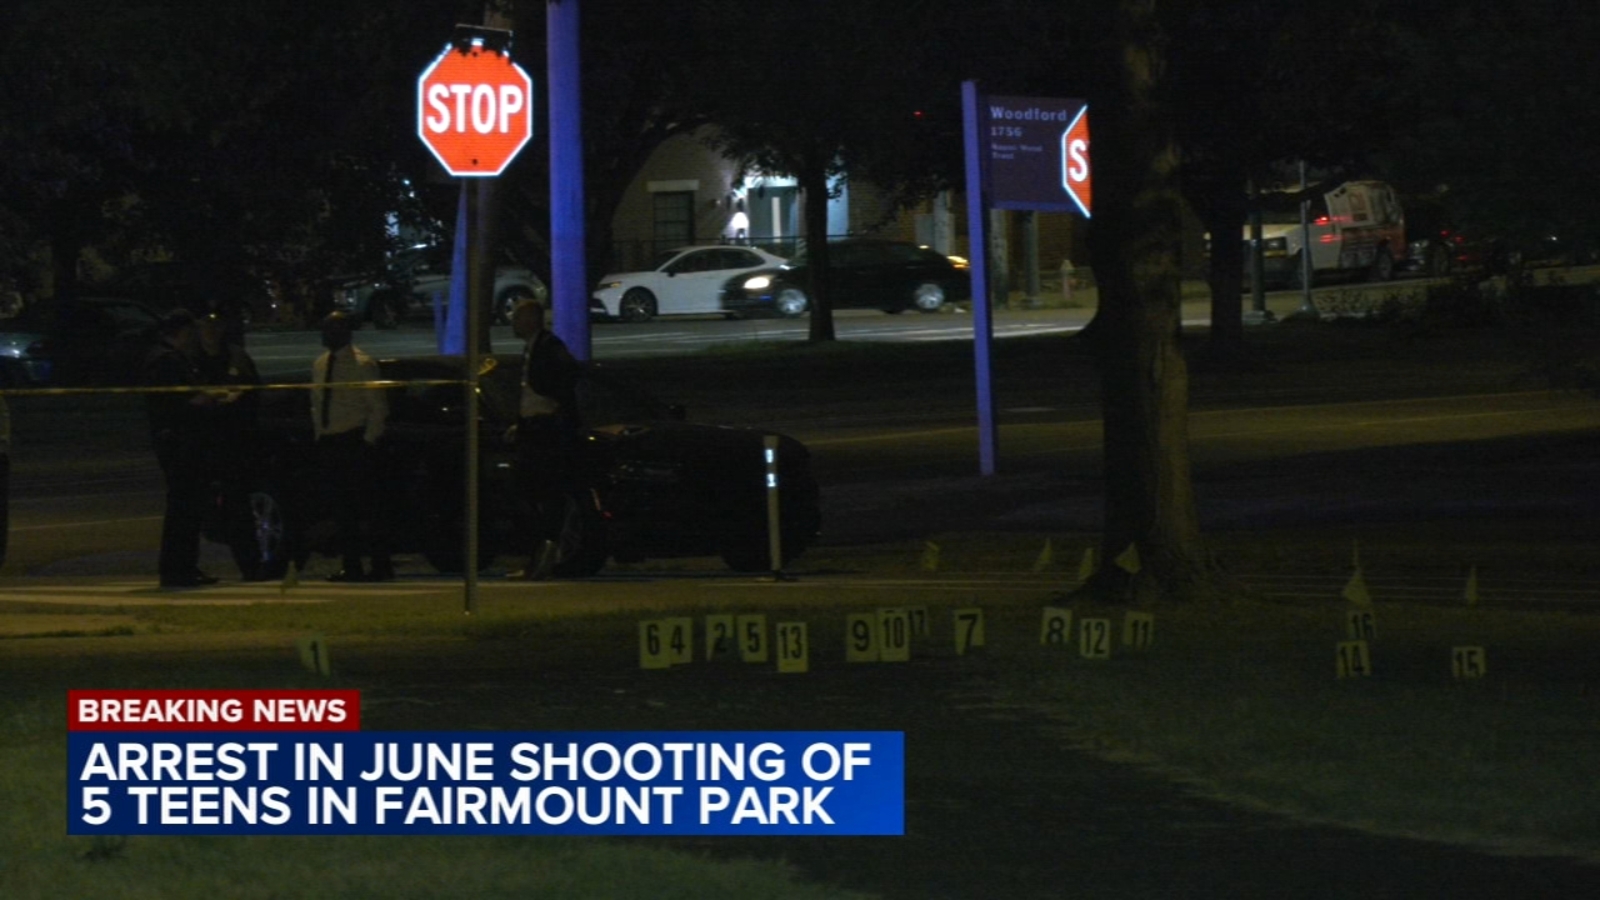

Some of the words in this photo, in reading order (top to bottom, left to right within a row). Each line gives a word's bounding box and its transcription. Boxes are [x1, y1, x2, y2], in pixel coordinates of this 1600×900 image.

[426, 83, 524, 134] STOP
[989, 105, 1068, 121] Woodford
[646, 622, 661, 656] 6
[670, 624, 686, 656] 4
[713, 621, 728, 653] 2
[746, 621, 761, 653] 5
[779, 625, 804, 660] 13
[852, 618, 870, 652] 9
[883, 616, 906, 649] 10
[958, 612, 979, 646] 7
[1047, 615, 1065, 645] 8
[1083, 620, 1106, 655] 12
